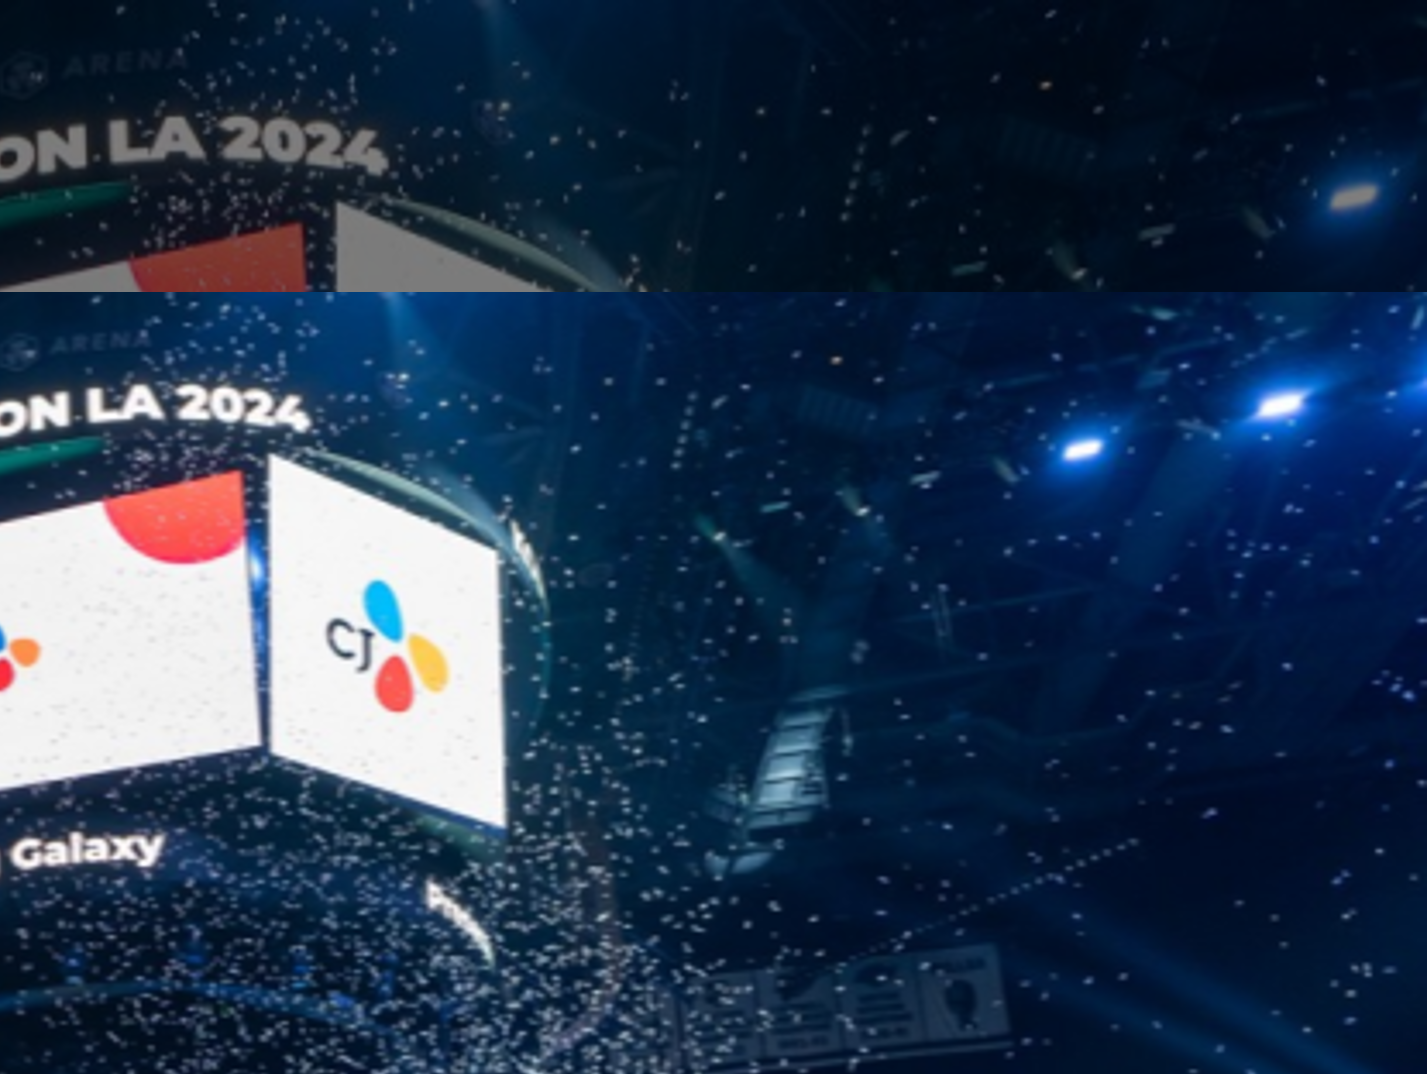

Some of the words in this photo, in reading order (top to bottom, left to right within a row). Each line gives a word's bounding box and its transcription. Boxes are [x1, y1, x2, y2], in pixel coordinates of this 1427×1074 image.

[63, 49, 191, 80] ARENA
[109, 116, 207, 165] LA
[220, 115, 391, 177] 2024
[50, 331, 152, 355] ARENA
[86, 384, 166, 423] LA
[175, 383, 312, 434] 2024
[325, 617, 375, 674] CJ
[11, 832, 167, 869] Galaxy
